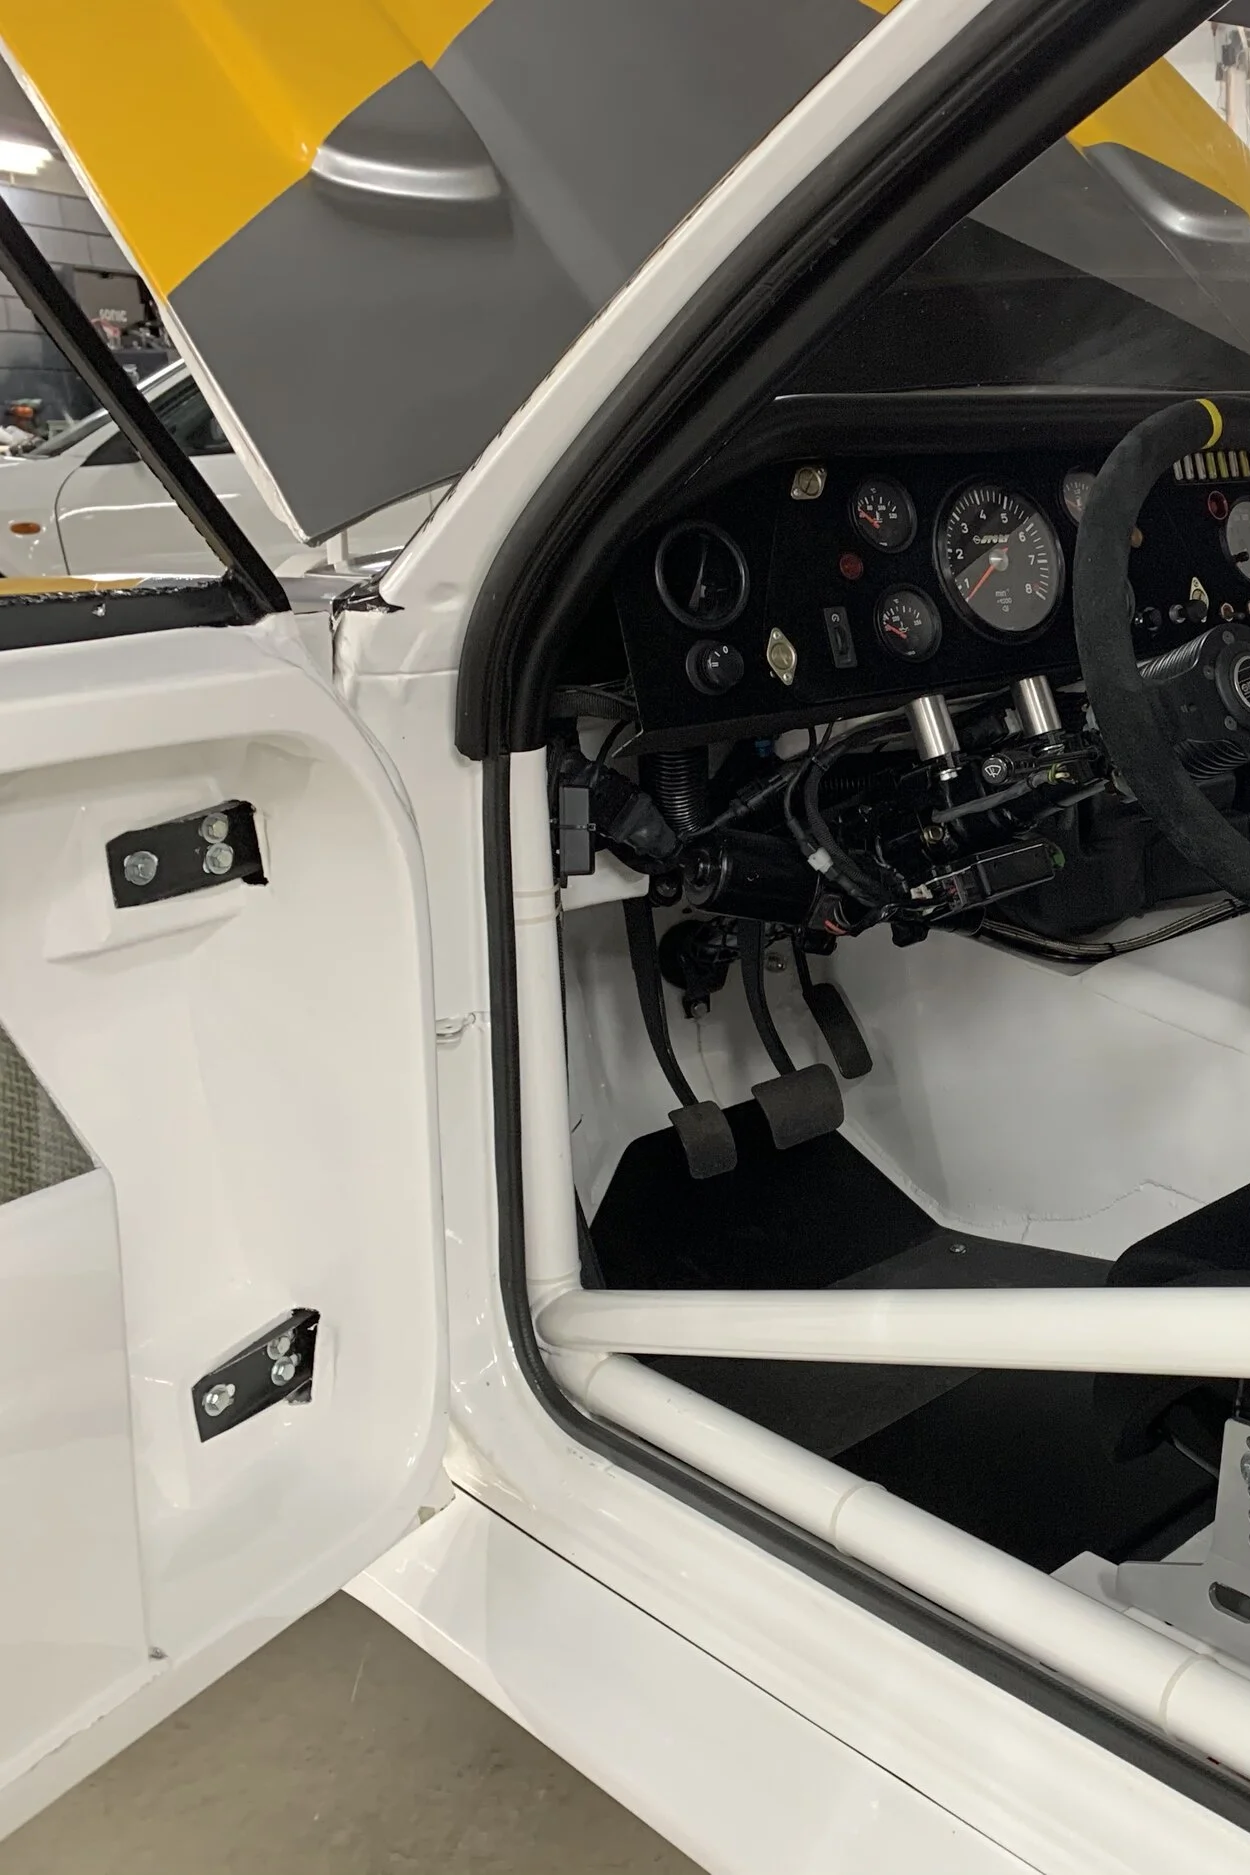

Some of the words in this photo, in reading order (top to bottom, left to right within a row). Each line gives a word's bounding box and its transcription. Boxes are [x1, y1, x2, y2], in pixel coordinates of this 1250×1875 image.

[979, 509, 987, 521] 4
[1000, 513, 1009, 524] 5
[961, 522, 969, 534] 3
[1018, 531, 1026, 542] 6
[955, 548, 964, 560] 2
[1027, 555, 1035, 566] 7
[964, 578, 970, 589] 1
[1025, 583, 1033, 594] 8
